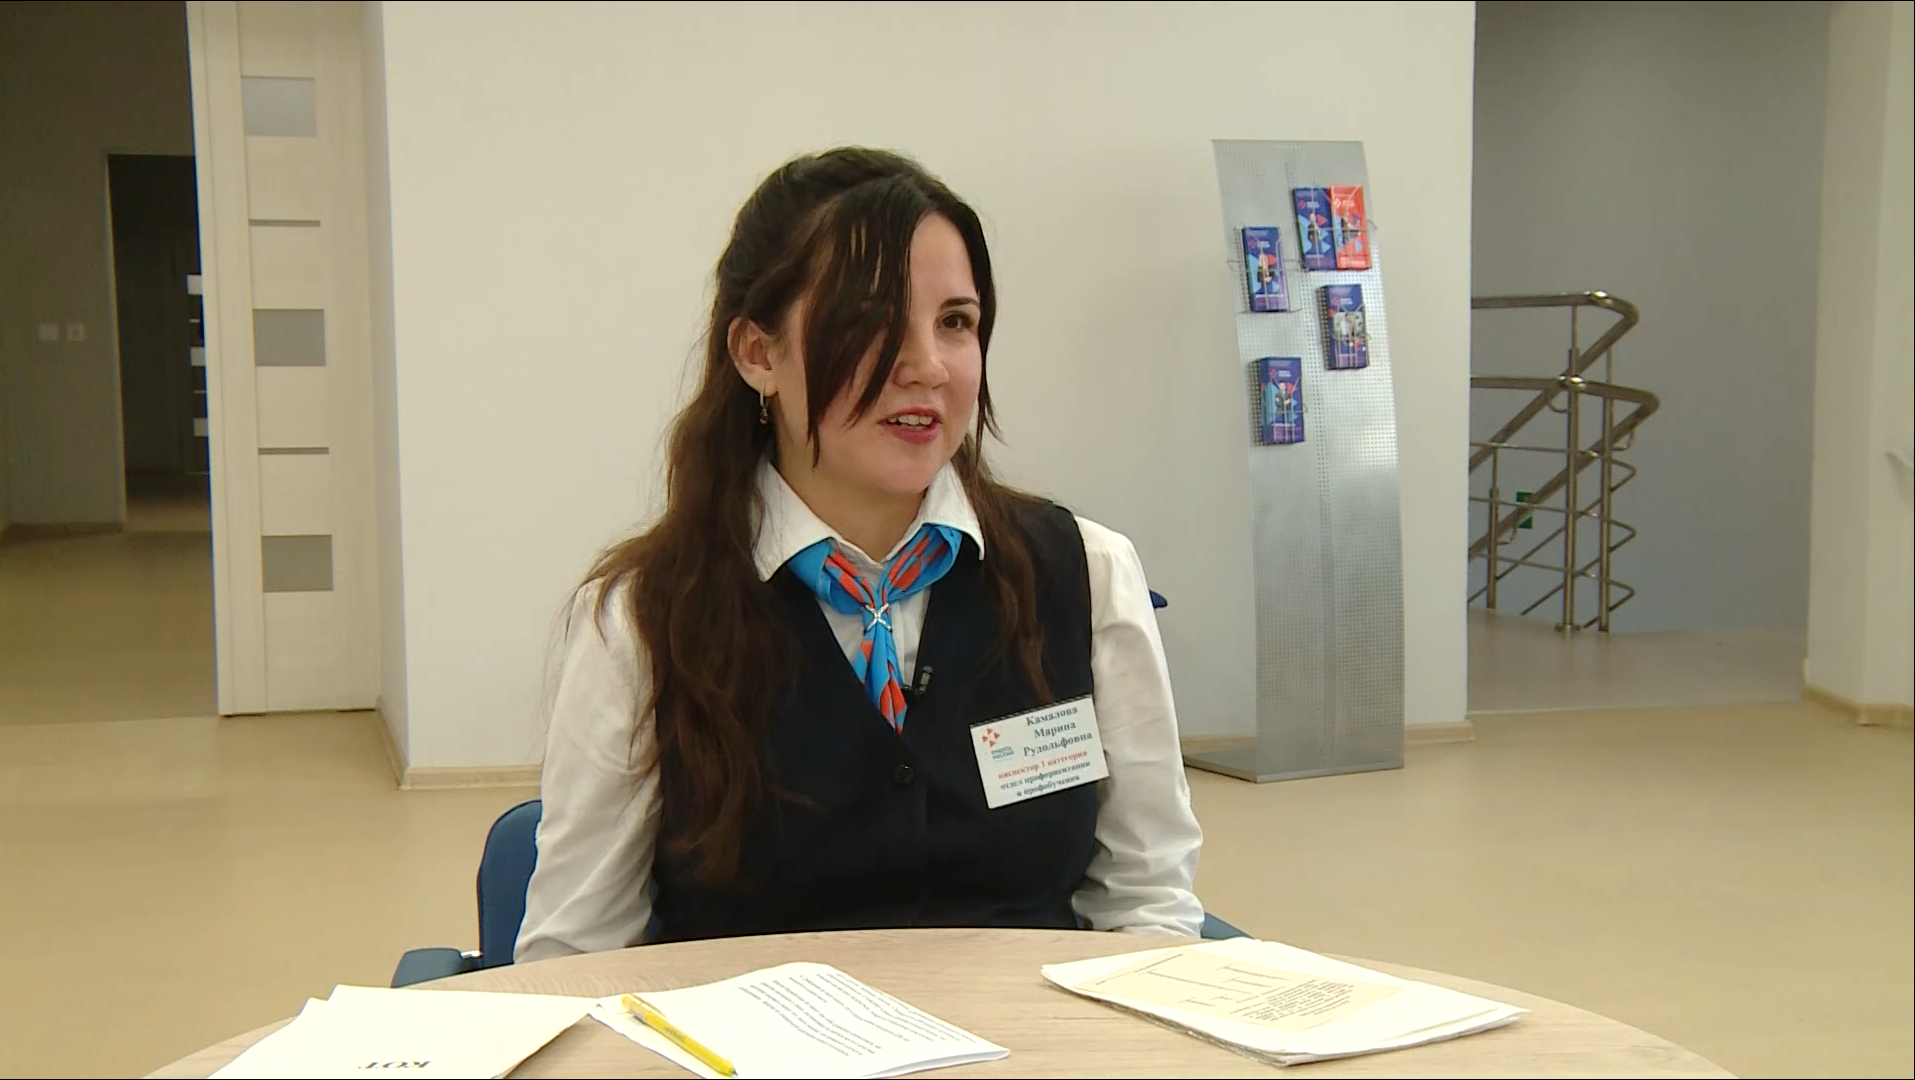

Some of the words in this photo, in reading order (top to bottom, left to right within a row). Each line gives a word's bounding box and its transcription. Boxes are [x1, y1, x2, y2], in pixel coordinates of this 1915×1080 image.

[1026, 706, 1078, 726] Камалова
[1034, 722, 1076, 739] Марина
[1023, 732, 1092, 757] Рудольфовна
[998, 764, 1039, 779] инспектор
[1047, 751, 1087, 767] категории
[1001, 777, 1023, 790] отдел
